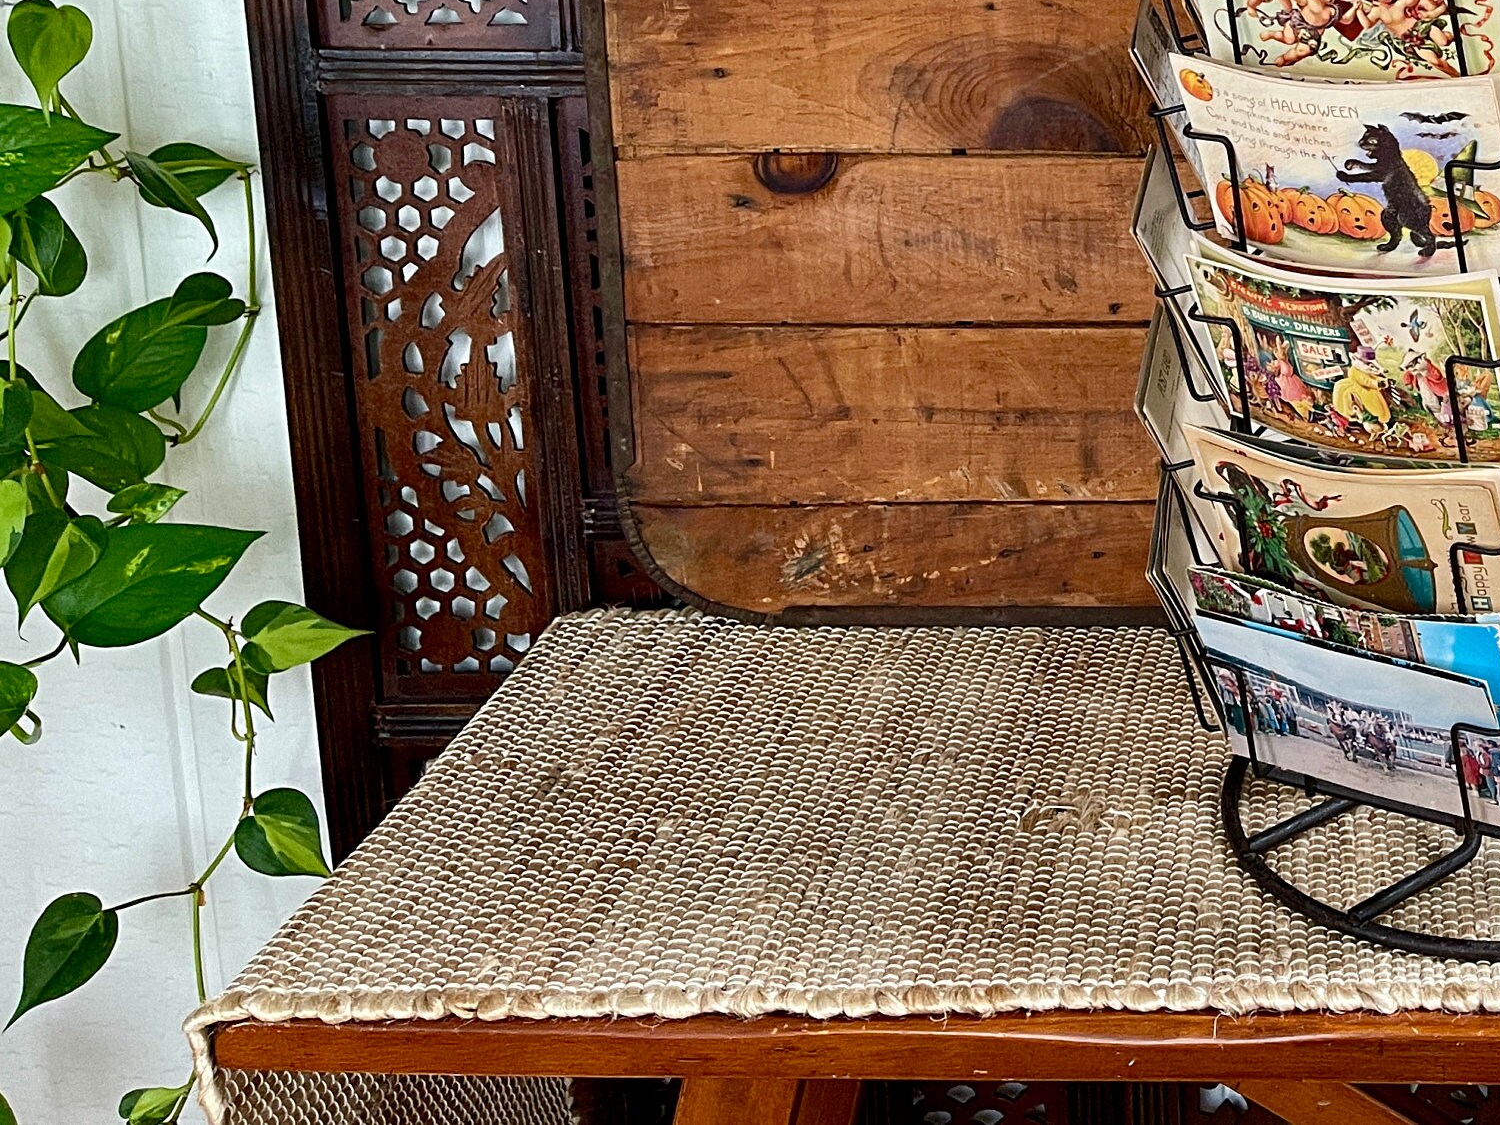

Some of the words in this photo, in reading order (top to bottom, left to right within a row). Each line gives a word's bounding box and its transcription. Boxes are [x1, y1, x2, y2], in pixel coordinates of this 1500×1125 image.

[1225, 99, 1272, 123] Pumpkins
[1273, 118, 1329, 133] everywhere
[1232, 92, 1255, 108] song
[1270, 97, 1359, 119] HALLOWEEN
[1231, 118, 1247, 130] and
[1273, 132, 1291, 142] and
[1293, 135, 1332, 148] witches
[1259, 139, 1298, 159] through
[1299, 149, 1318, 160] the
[1230, 280, 1272, 306] GIGANTIC
[1252, 309, 1270, 324] BUN
[1271, 316, 1279, 327] &
[1292, 321, 1341, 337] DRAPERS
[1301, 343, 1329, 357] SALE
[1455, 501, 1478, 535] Year
[1471, 566, 1494, 612] Happy
